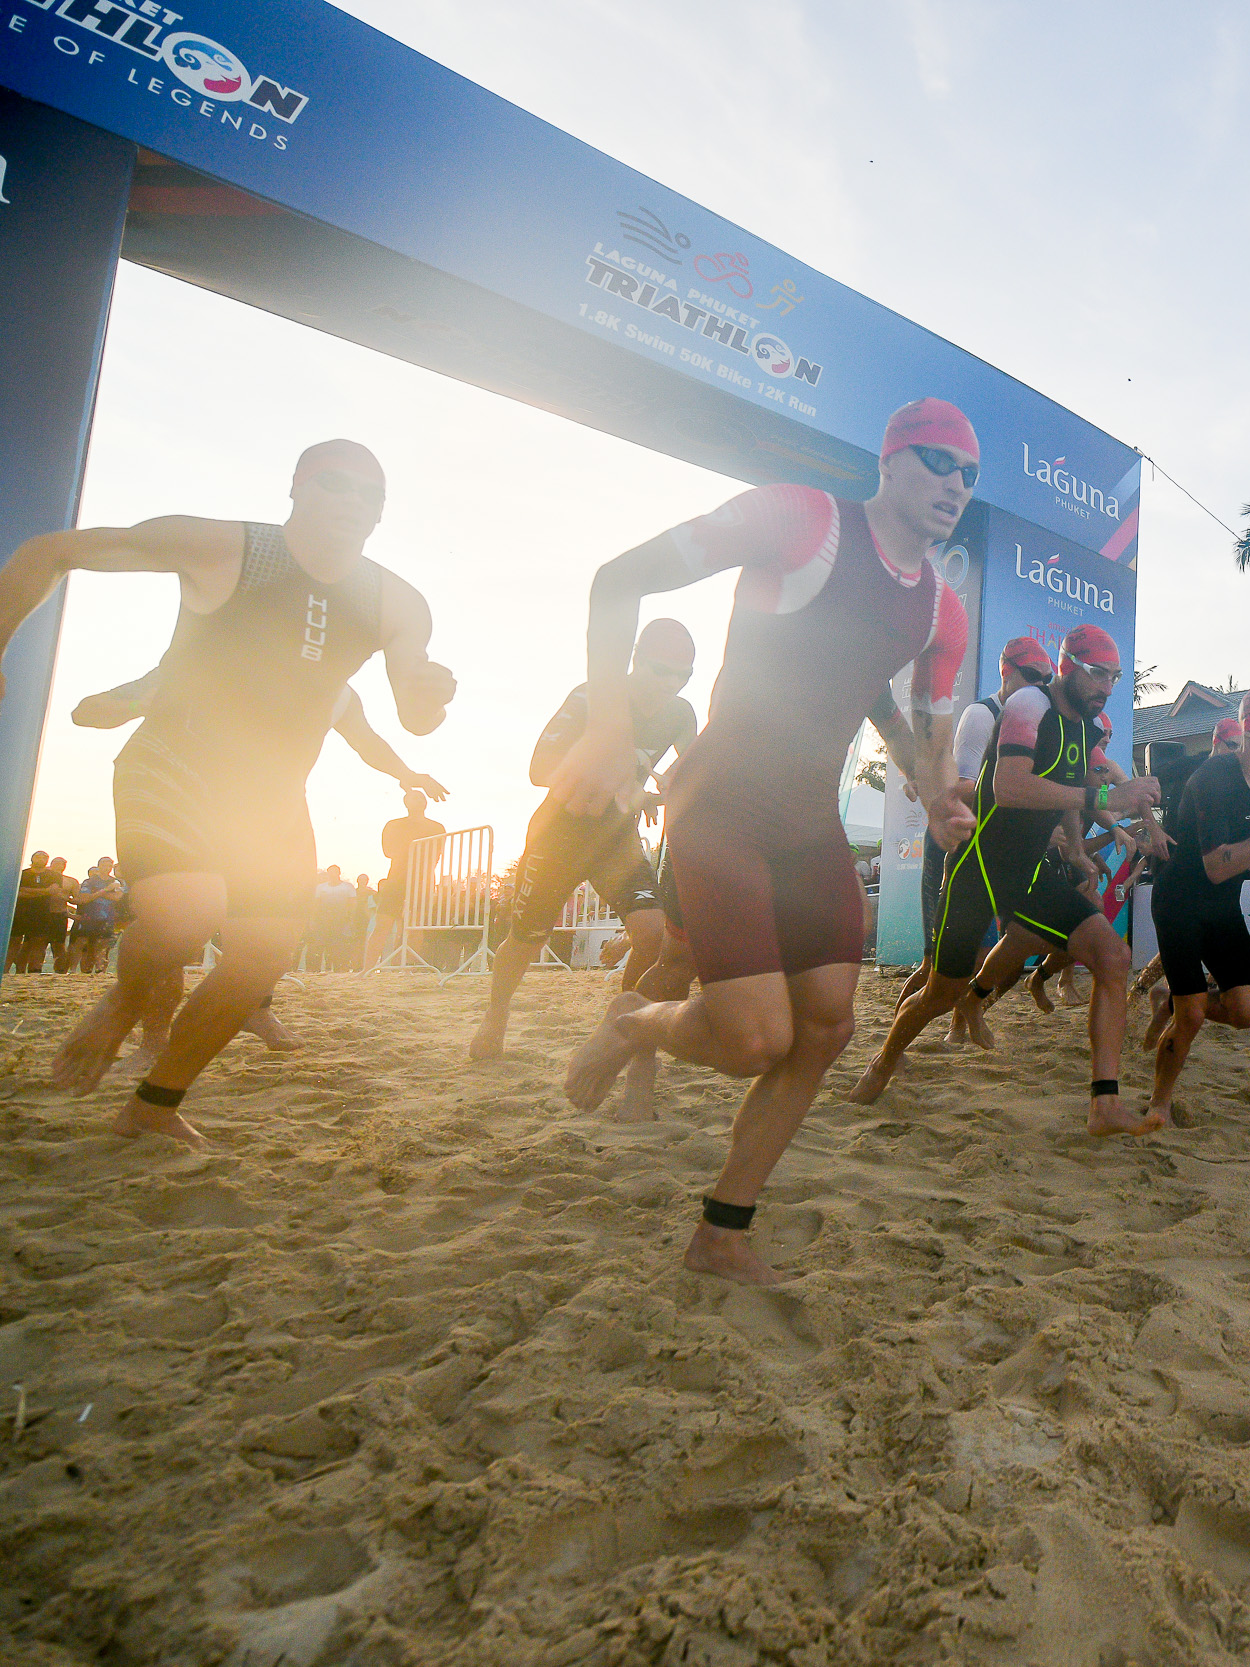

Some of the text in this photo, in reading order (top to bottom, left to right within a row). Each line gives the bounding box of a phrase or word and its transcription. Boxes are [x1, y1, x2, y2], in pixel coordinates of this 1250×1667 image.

[53, 35, 105, 65] OF
[128, 68, 289, 151] LEGENDS
[585, 254, 824, 388] TRIATHLON
[593, 242, 761, 330] LAGUNA PHUKET
[578, 302, 817, 417] 1.8K Swim 50K Bike 12K Run
[1055, 496, 1091, 520] PHUKET
[1048, 596, 1084, 617] PHUKET
